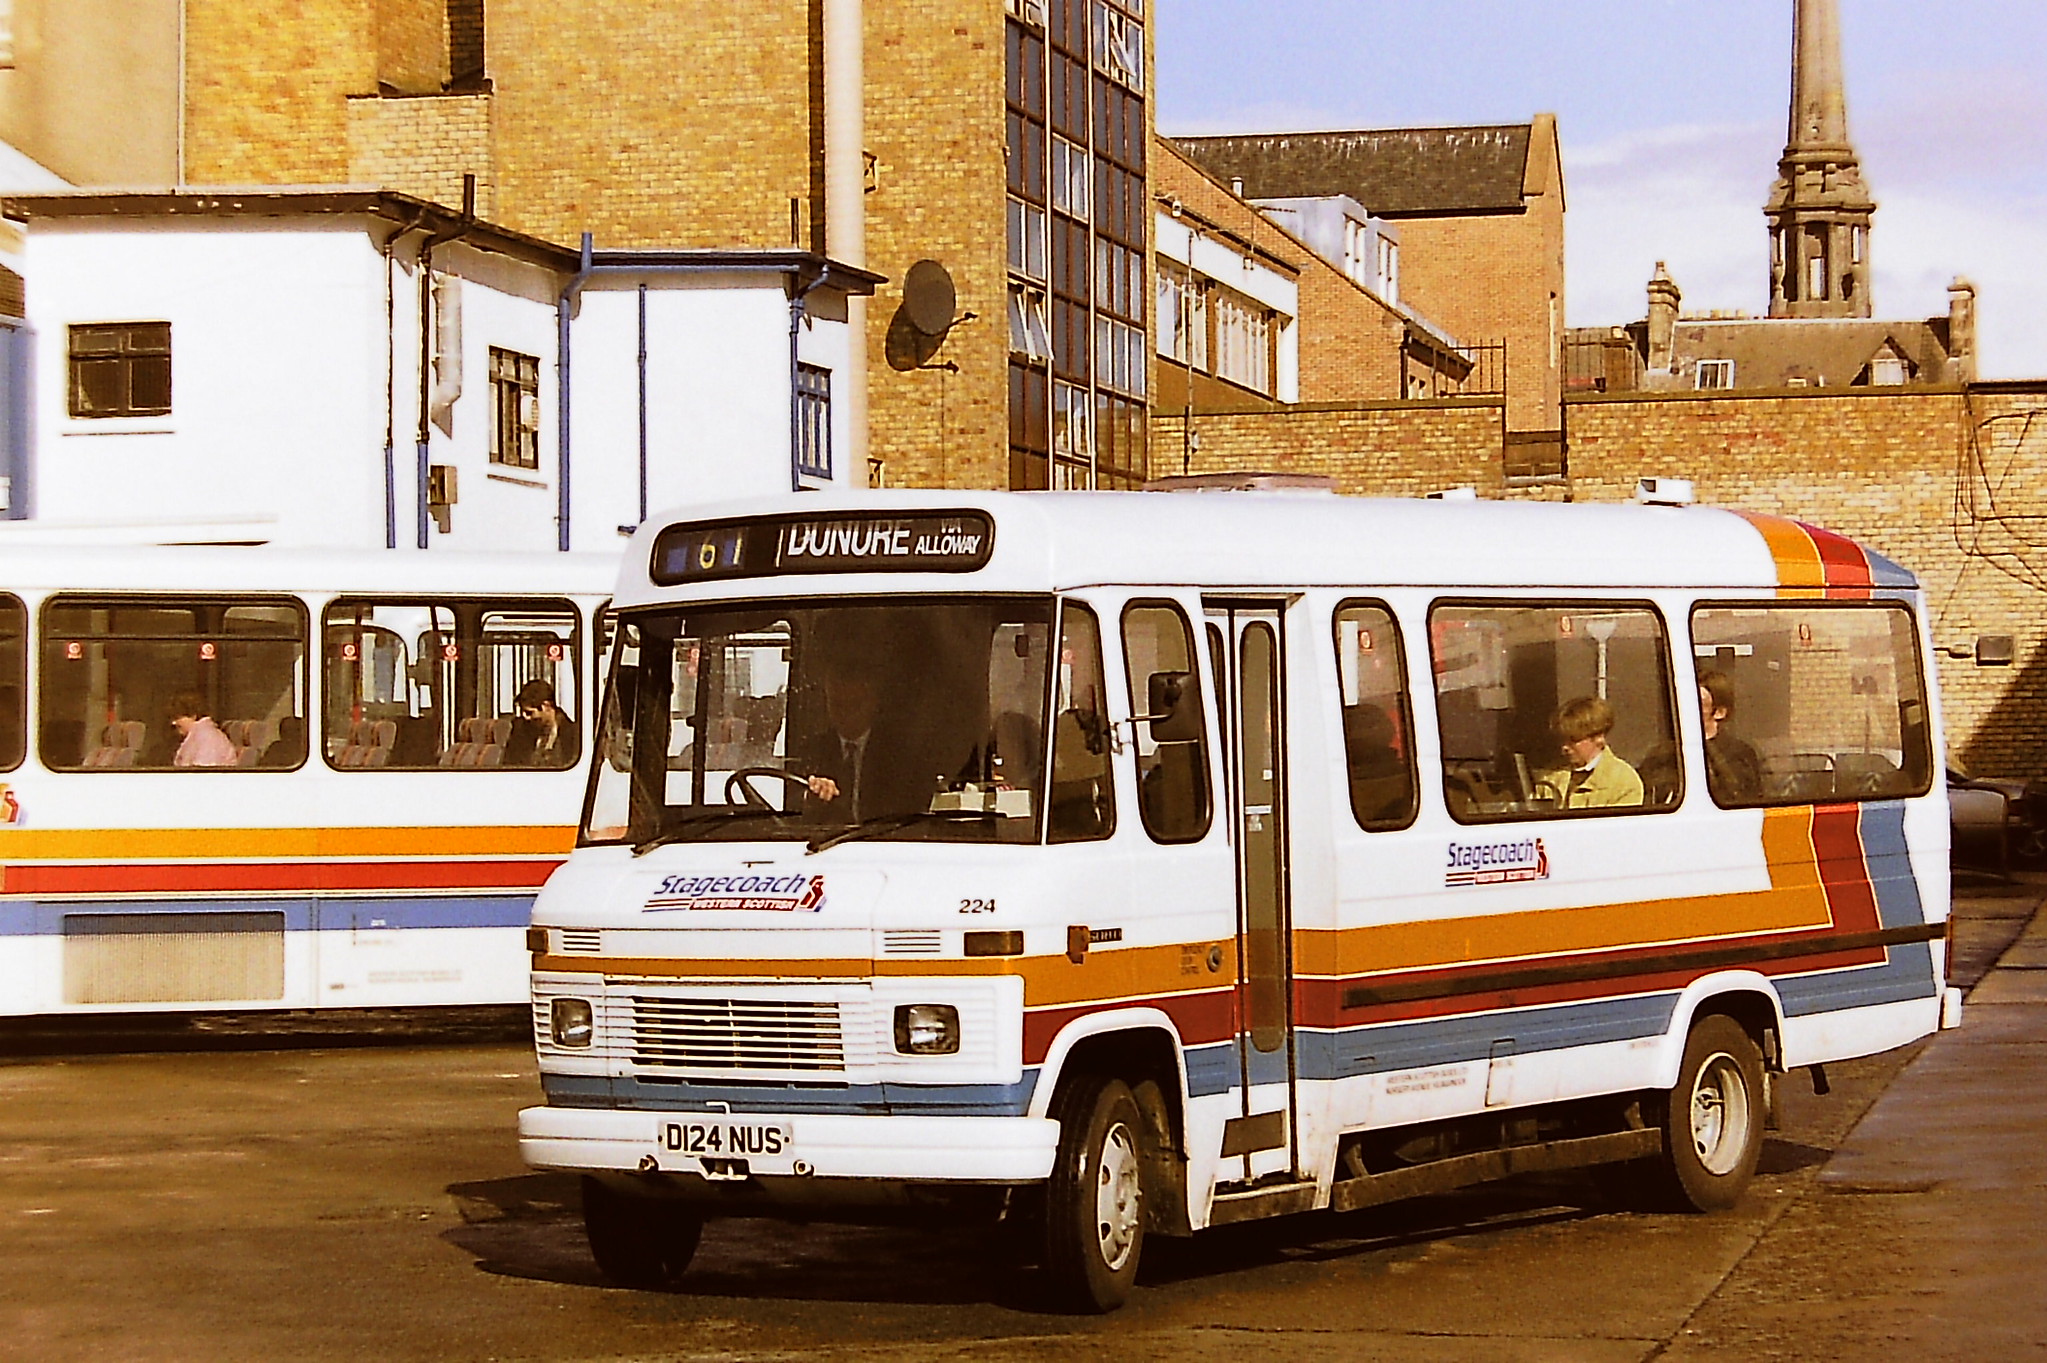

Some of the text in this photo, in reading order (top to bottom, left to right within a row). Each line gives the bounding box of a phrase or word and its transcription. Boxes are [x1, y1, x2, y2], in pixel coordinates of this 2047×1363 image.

[788, 521, 910, 557] DUNURE
[914, 534, 981, 555] ALLOWAY
[1447, 838, 1534, 870] Stagecoach
[653, 873, 807, 897] Stagecoach
[743, 900, 796, 910] SCOTTISH
[959, 898, 996, 914] 224
[666, 1123, 783, 1154] D124 NUS
